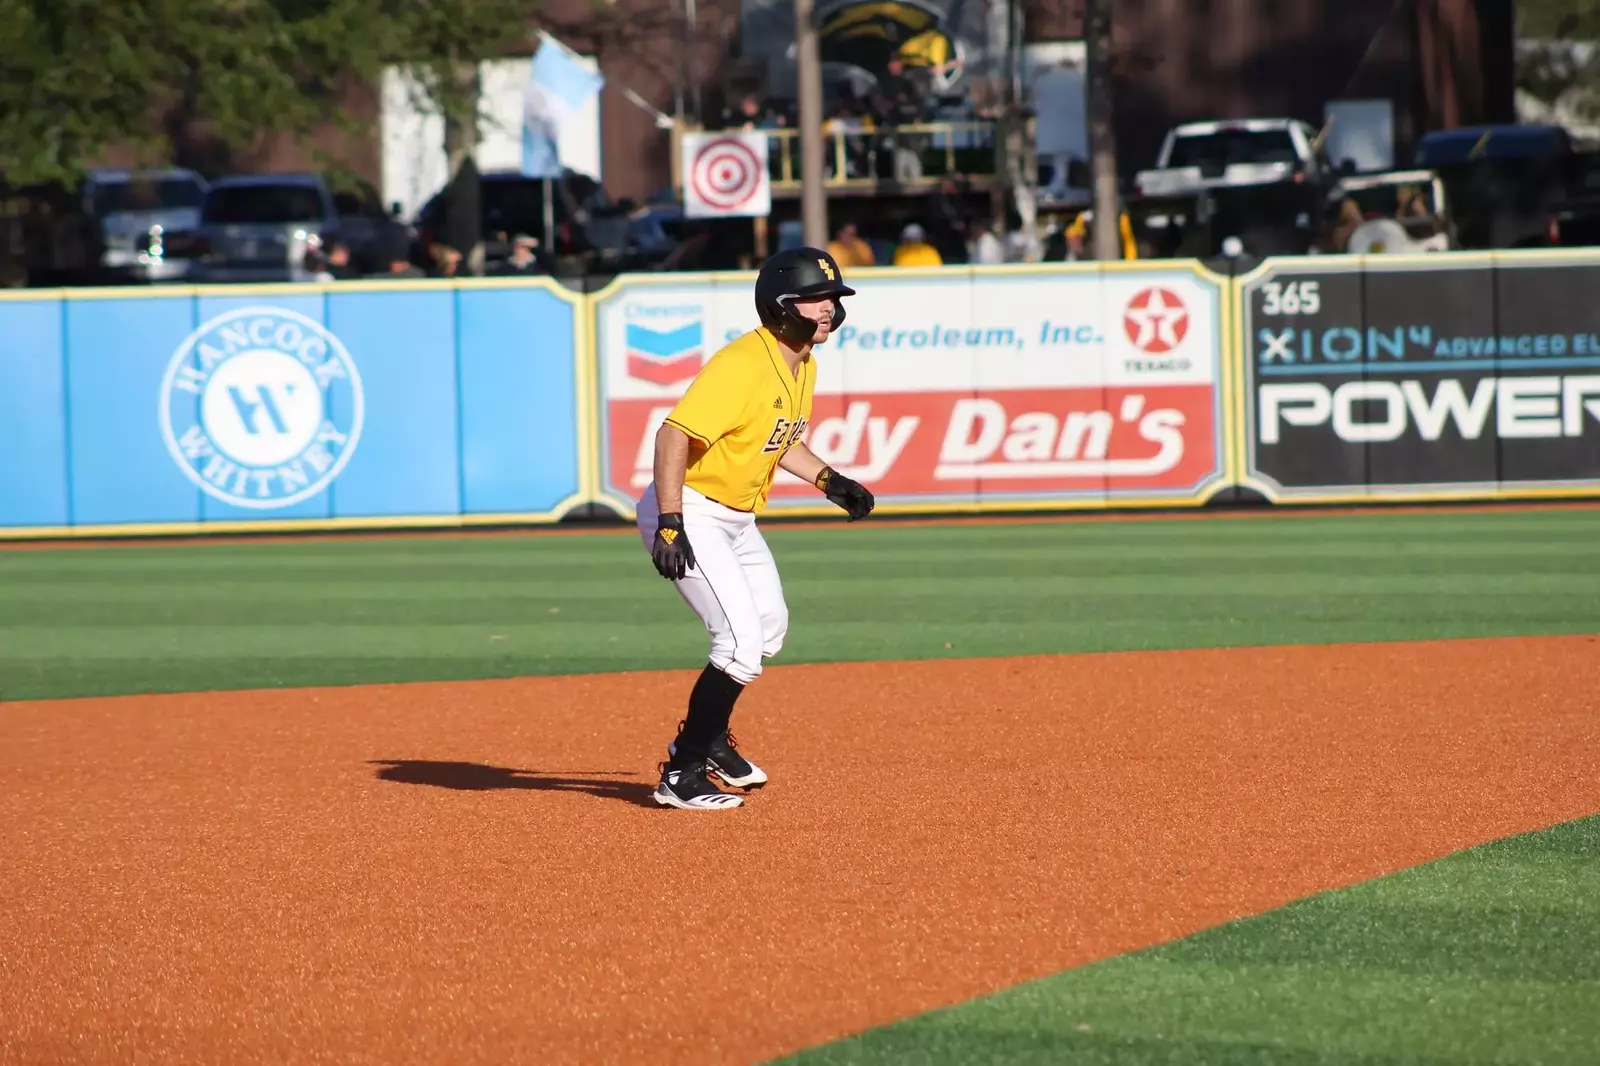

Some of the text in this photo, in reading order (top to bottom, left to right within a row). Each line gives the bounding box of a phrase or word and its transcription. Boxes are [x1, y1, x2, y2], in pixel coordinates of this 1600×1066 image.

[1261, 281, 1321, 315] 365
[836, 323, 1025, 350] Petroleum,
[1039, 320, 1104, 344] Inc.
[1434, 333, 1567, 358] ADVANCED
[174, 317, 347, 394] HANCOCK
[1124, 357, 1193, 374] TEXACO
[932, 393, 1187, 481] Dan's
[179, 420, 348, 497] WHITNEY
